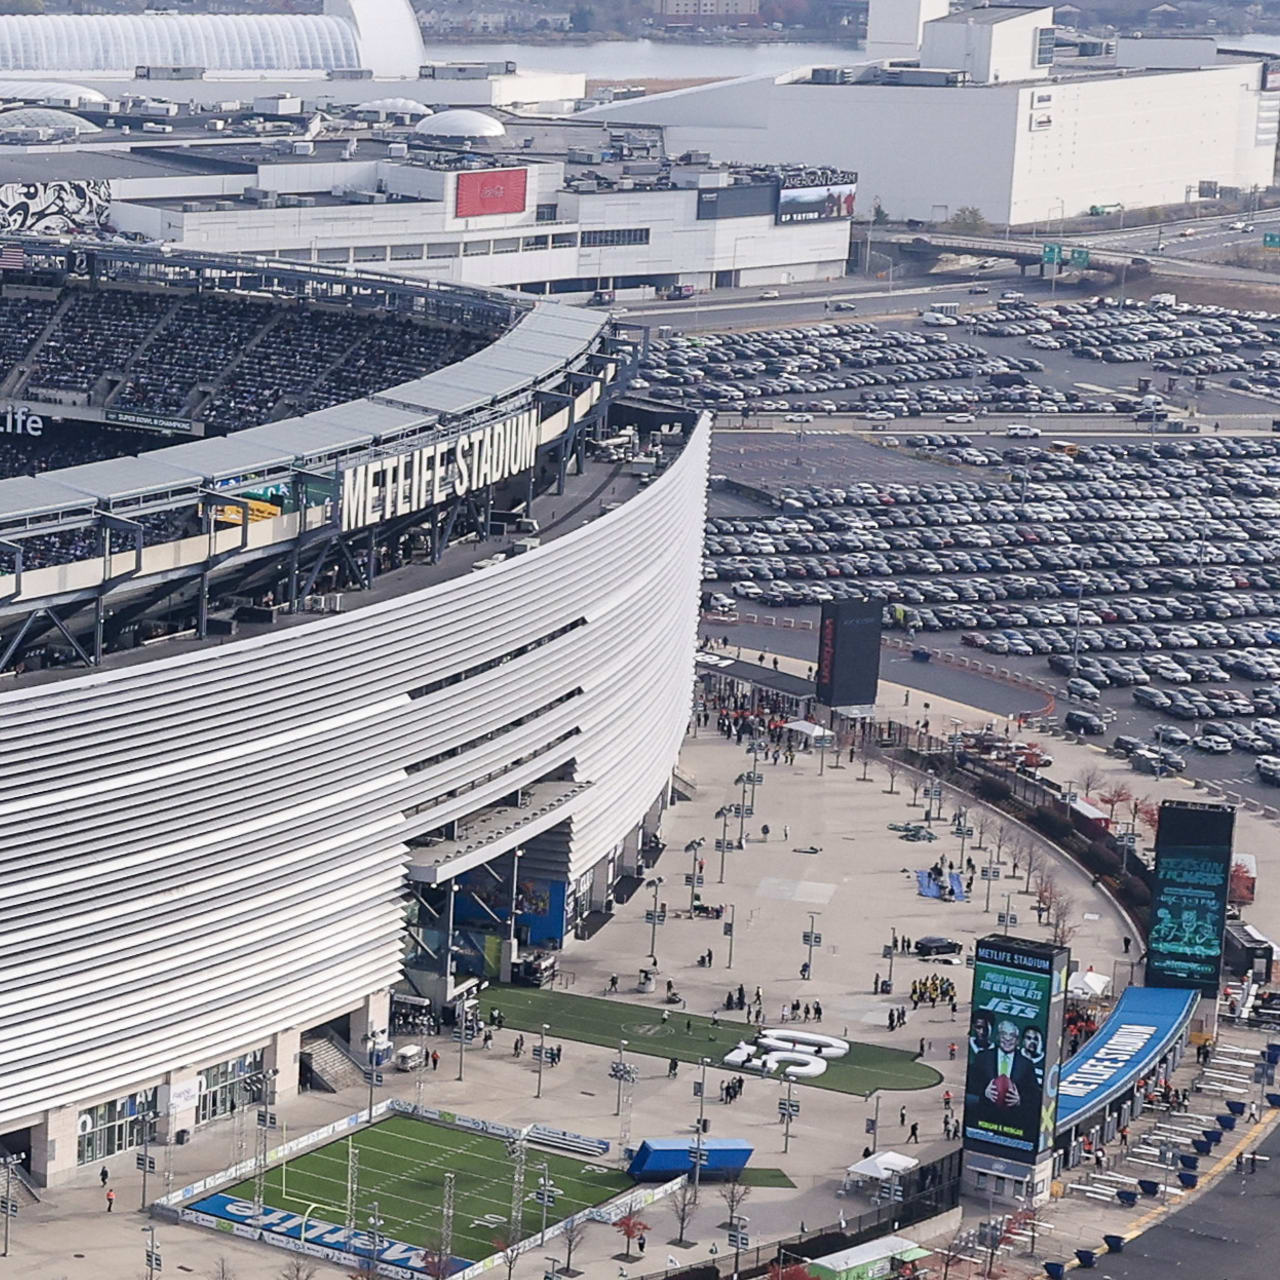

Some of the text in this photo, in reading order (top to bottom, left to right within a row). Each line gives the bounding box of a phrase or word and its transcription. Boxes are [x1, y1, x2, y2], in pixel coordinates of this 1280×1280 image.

[784, 171, 858, 188] AMERICAN DREAM
[342, 408, 538, 533] METLIFE STADIUM
[978, 947, 1050, 970] METLIFE STADIUM
[978, 996, 1040, 1019] JETS
[1059, 1024, 1158, 1097] METLIFE STADIUM
[225, 1201, 428, 1268] MetLife
